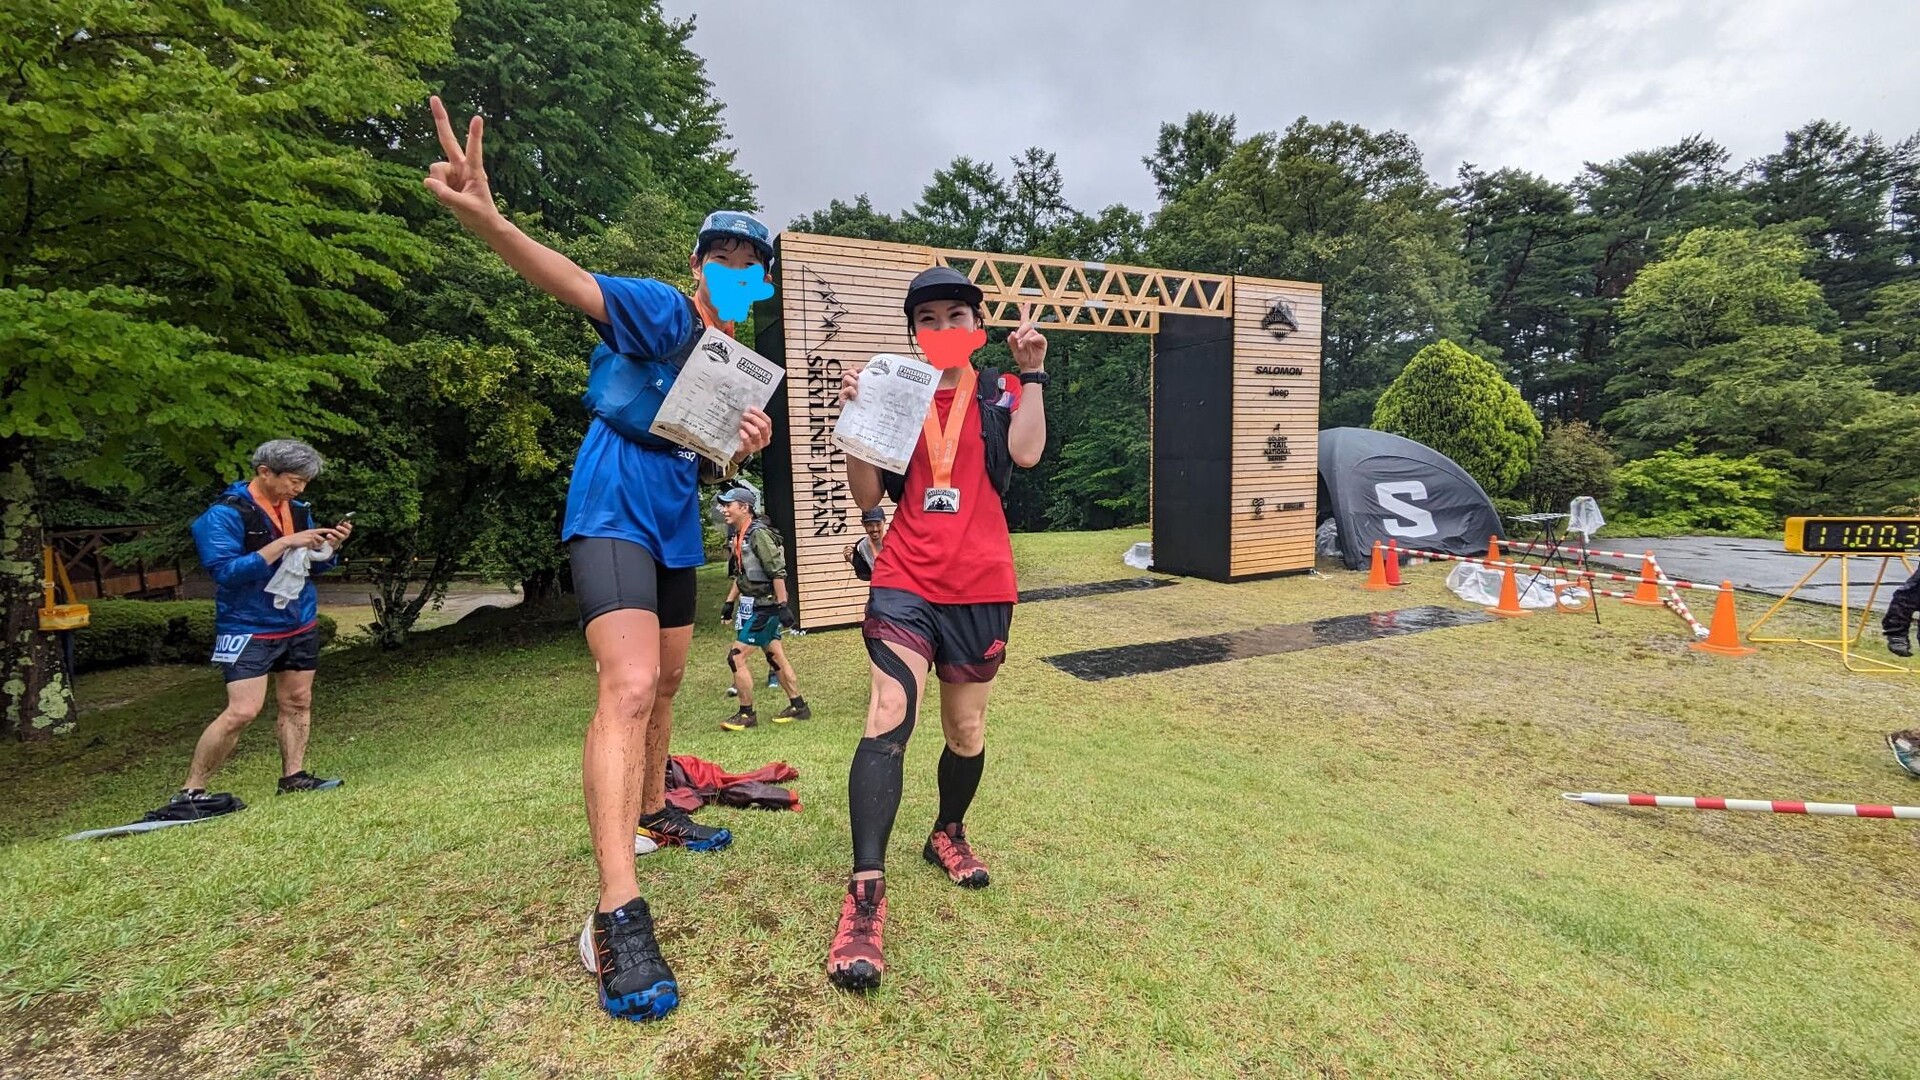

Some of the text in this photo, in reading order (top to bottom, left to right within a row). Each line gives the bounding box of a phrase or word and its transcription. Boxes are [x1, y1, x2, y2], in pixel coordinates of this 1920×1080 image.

[1255, 366, 1303, 376] SALOMON
[1269, 386, 1289, 398] Jeep
[807, 354, 830, 537] SKYLINE JAPAN
[832, 478, 848, 535] ALPS
[1375, 480, 1438, 538] S
